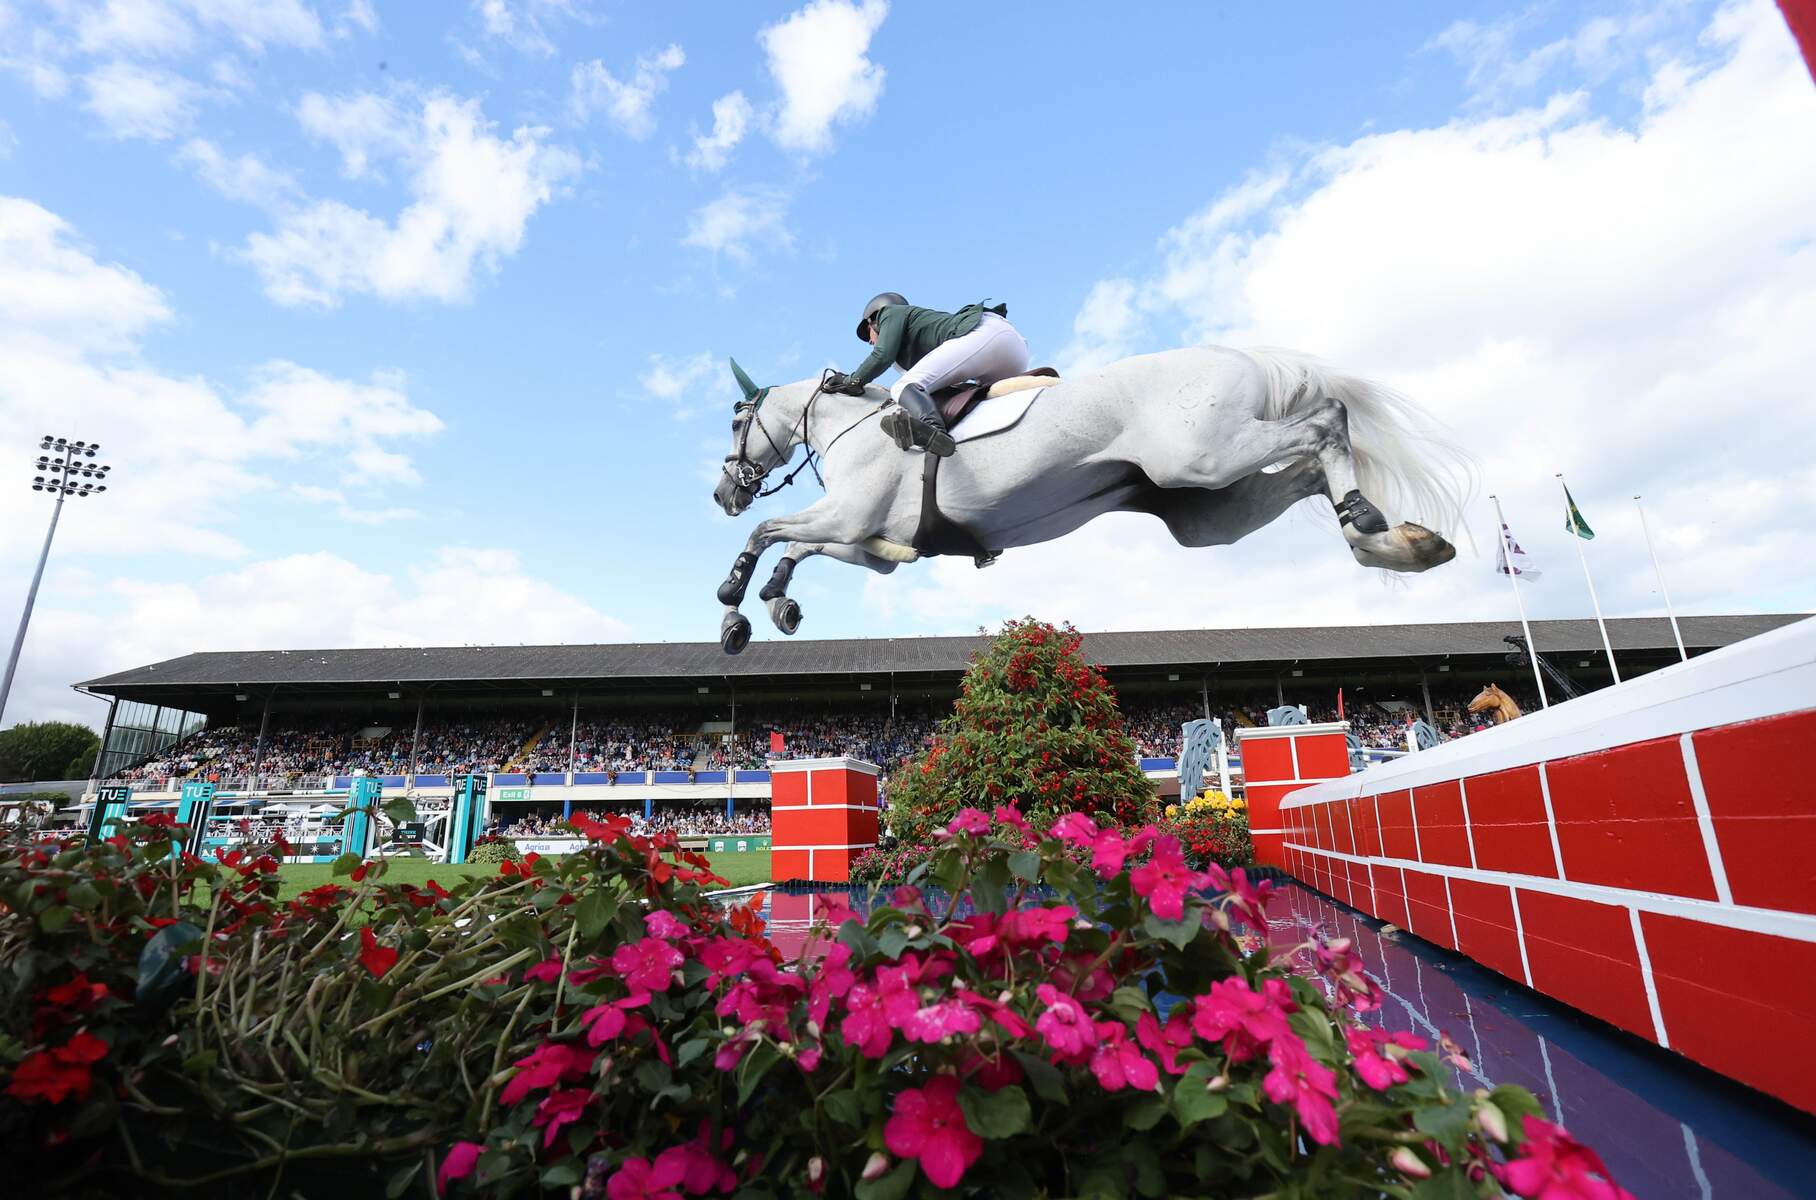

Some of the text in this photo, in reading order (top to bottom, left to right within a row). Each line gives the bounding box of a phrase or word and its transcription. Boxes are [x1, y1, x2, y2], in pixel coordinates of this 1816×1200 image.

[456, 779, 467, 791] TUE
[473, 778, 487, 791] TUE
[101, 789, 126, 800] TUE
[185, 786, 211, 798] TUE
